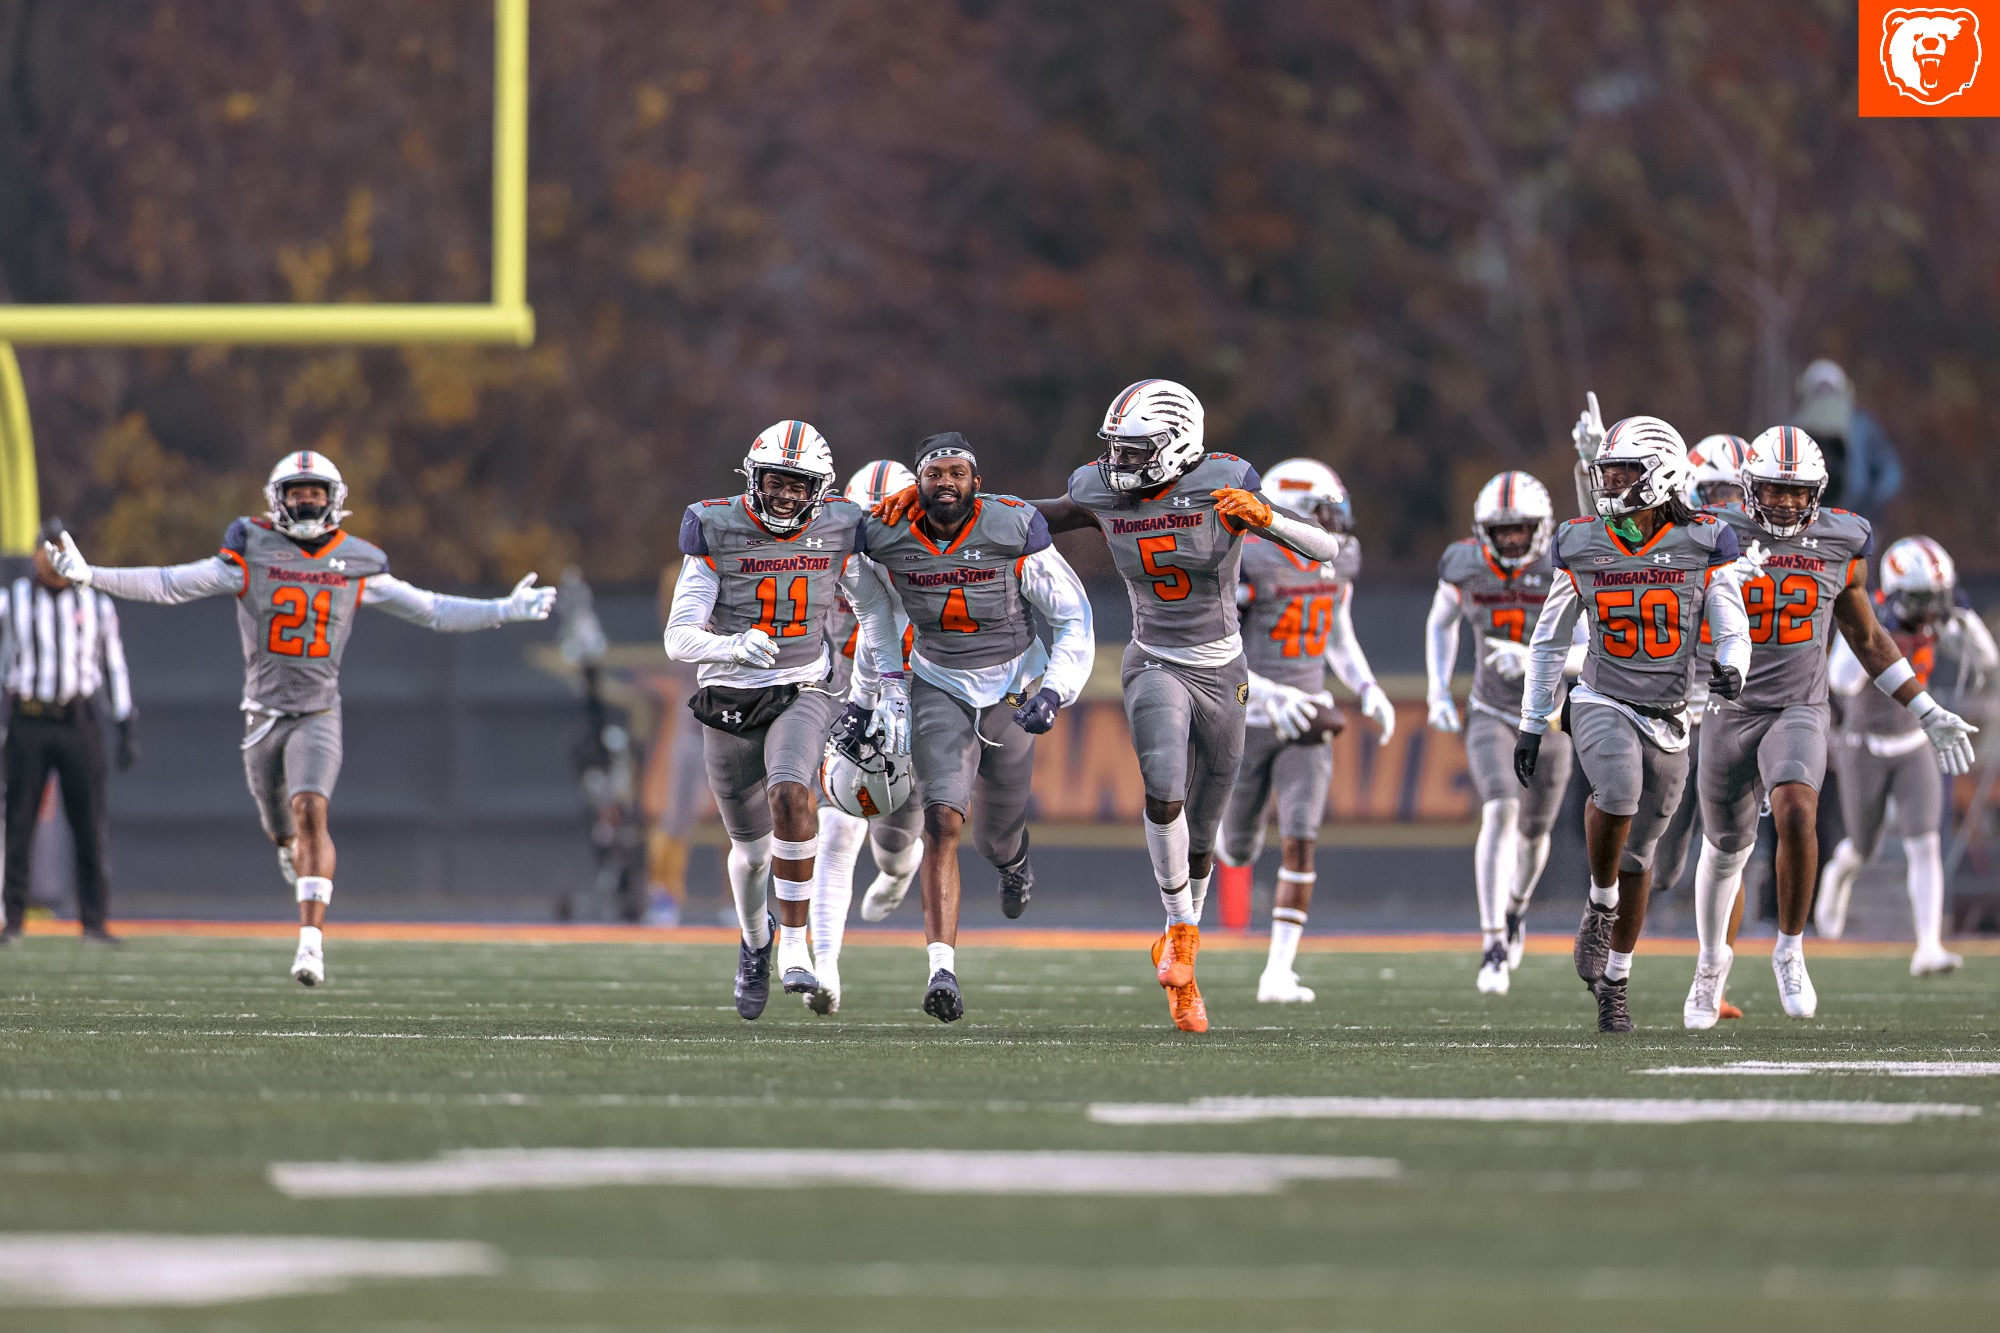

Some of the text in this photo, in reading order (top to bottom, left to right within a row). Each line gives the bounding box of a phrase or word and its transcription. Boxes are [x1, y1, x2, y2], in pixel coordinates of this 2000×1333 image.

[782, 459, 799, 467] 1867
[1109, 512, 1204, 534] MORGAN STATE
[736, 554, 831, 573] MORGAN STATE
[904, 568, 998, 587] MORGAN STATE
[1137, 534, 1192, 602] 5
[1593, 568, 1686, 587] MORGAN STATE
[1790, 553, 1827, 572] STATE
[267, 586, 332, 659] 21
[751, 576, 808, 638] 11
[940, 587, 980, 634] 4
[1270, 594, 1334, 658] 40
[1595, 587, 1682, 660] 50
[1741, 573, 1819, 645] 92
